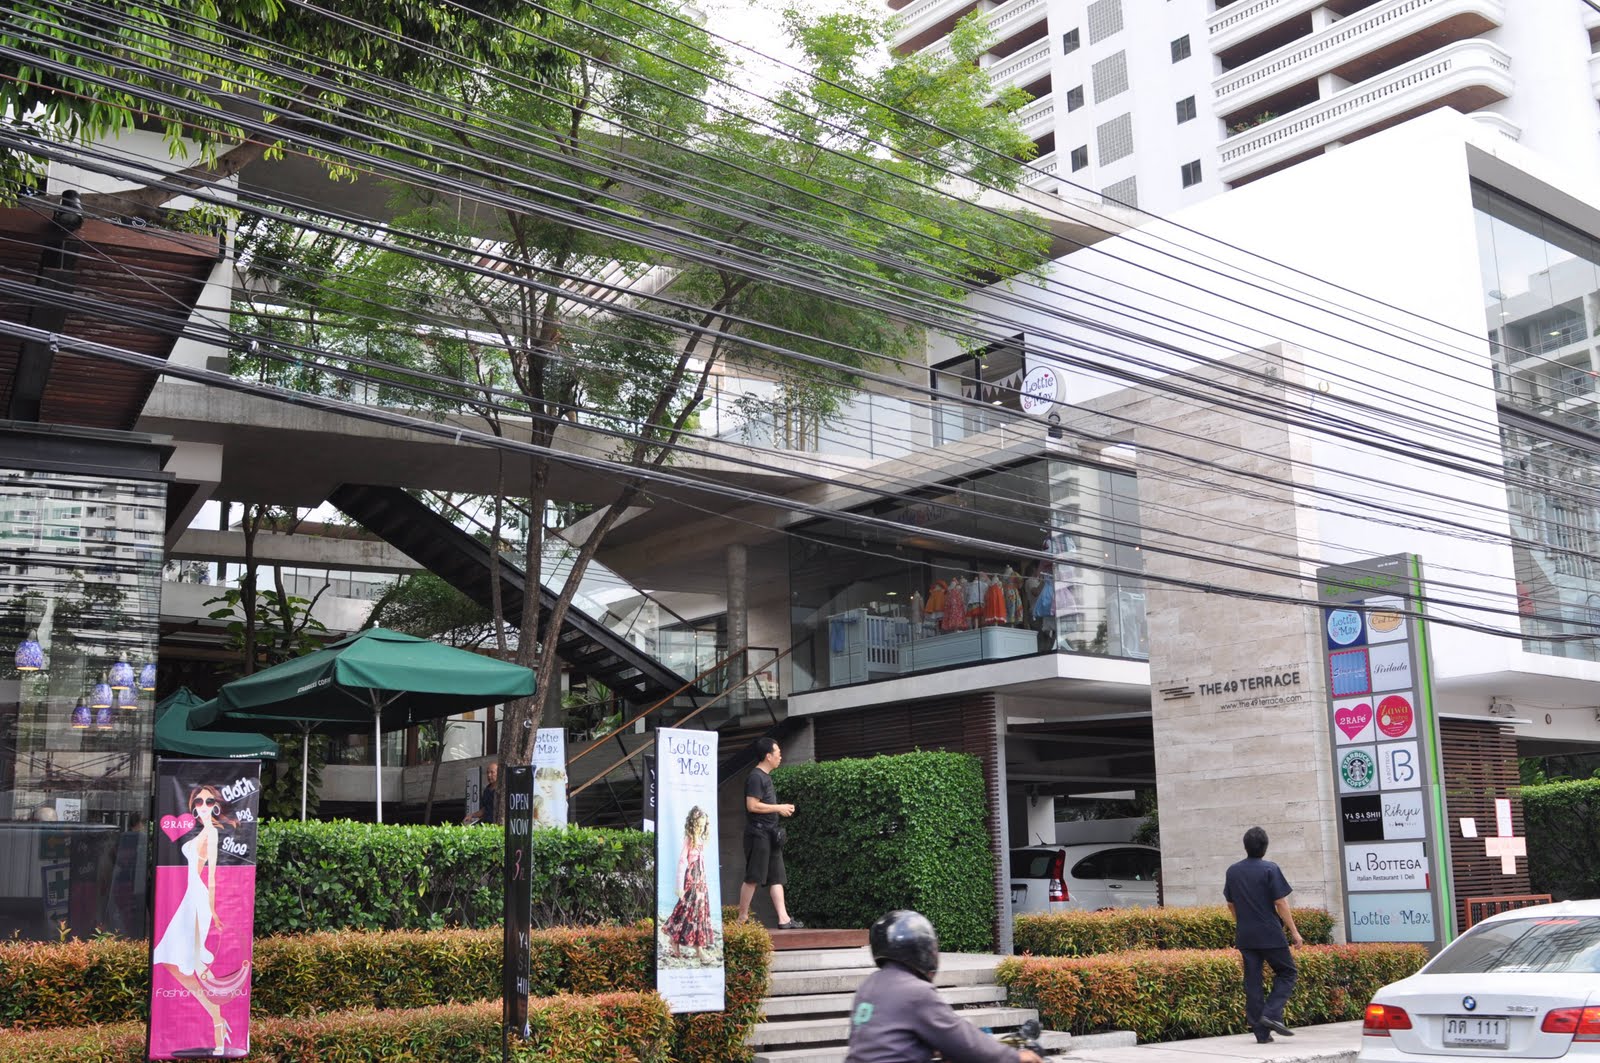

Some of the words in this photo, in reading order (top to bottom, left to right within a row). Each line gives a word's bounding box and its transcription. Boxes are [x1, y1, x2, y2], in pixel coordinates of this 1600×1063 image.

[1025, 374, 1054, 393] Lottie
[1332, 615, 1357, 627] Lottie
[1339, 626, 1358, 636] Max
[1199, 682, 1223, 696] THE
[1223, 680, 1239, 693] 49
[1240, 672, 1300, 691] TERRACE
[1220, 695, 1302, 710] www.the49terrace.com
[1380, 704, 1409, 716] Zawa
[536, 732, 559, 743] ottie
[668, 736, 710, 756] Lottie
[536, 744, 559, 754] Max
[677, 757, 710, 776] Max
[1343, 751, 1373, 769] STARBUCKS
[221, 776, 256, 802] Cloth
[1346, 777, 1370, 788] COFFEE
[509, 793, 529, 810] OPEN
[162, 819, 194, 829] 2RAFé
[510, 818, 529, 836] NOW
[222, 836, 248, 855] Shoe
[1349, 861, 1362, 872] LA
[1366, 852, 1422, 871] BOTTEGA
[1352, 911, 1391, 926] Lottie
[1400, 909, 1430, 925] Max
[155, 987, 195, 998] Fashion
[228, 987, 248, 999] you
[1477, 1020, 1499, 1035] 111
